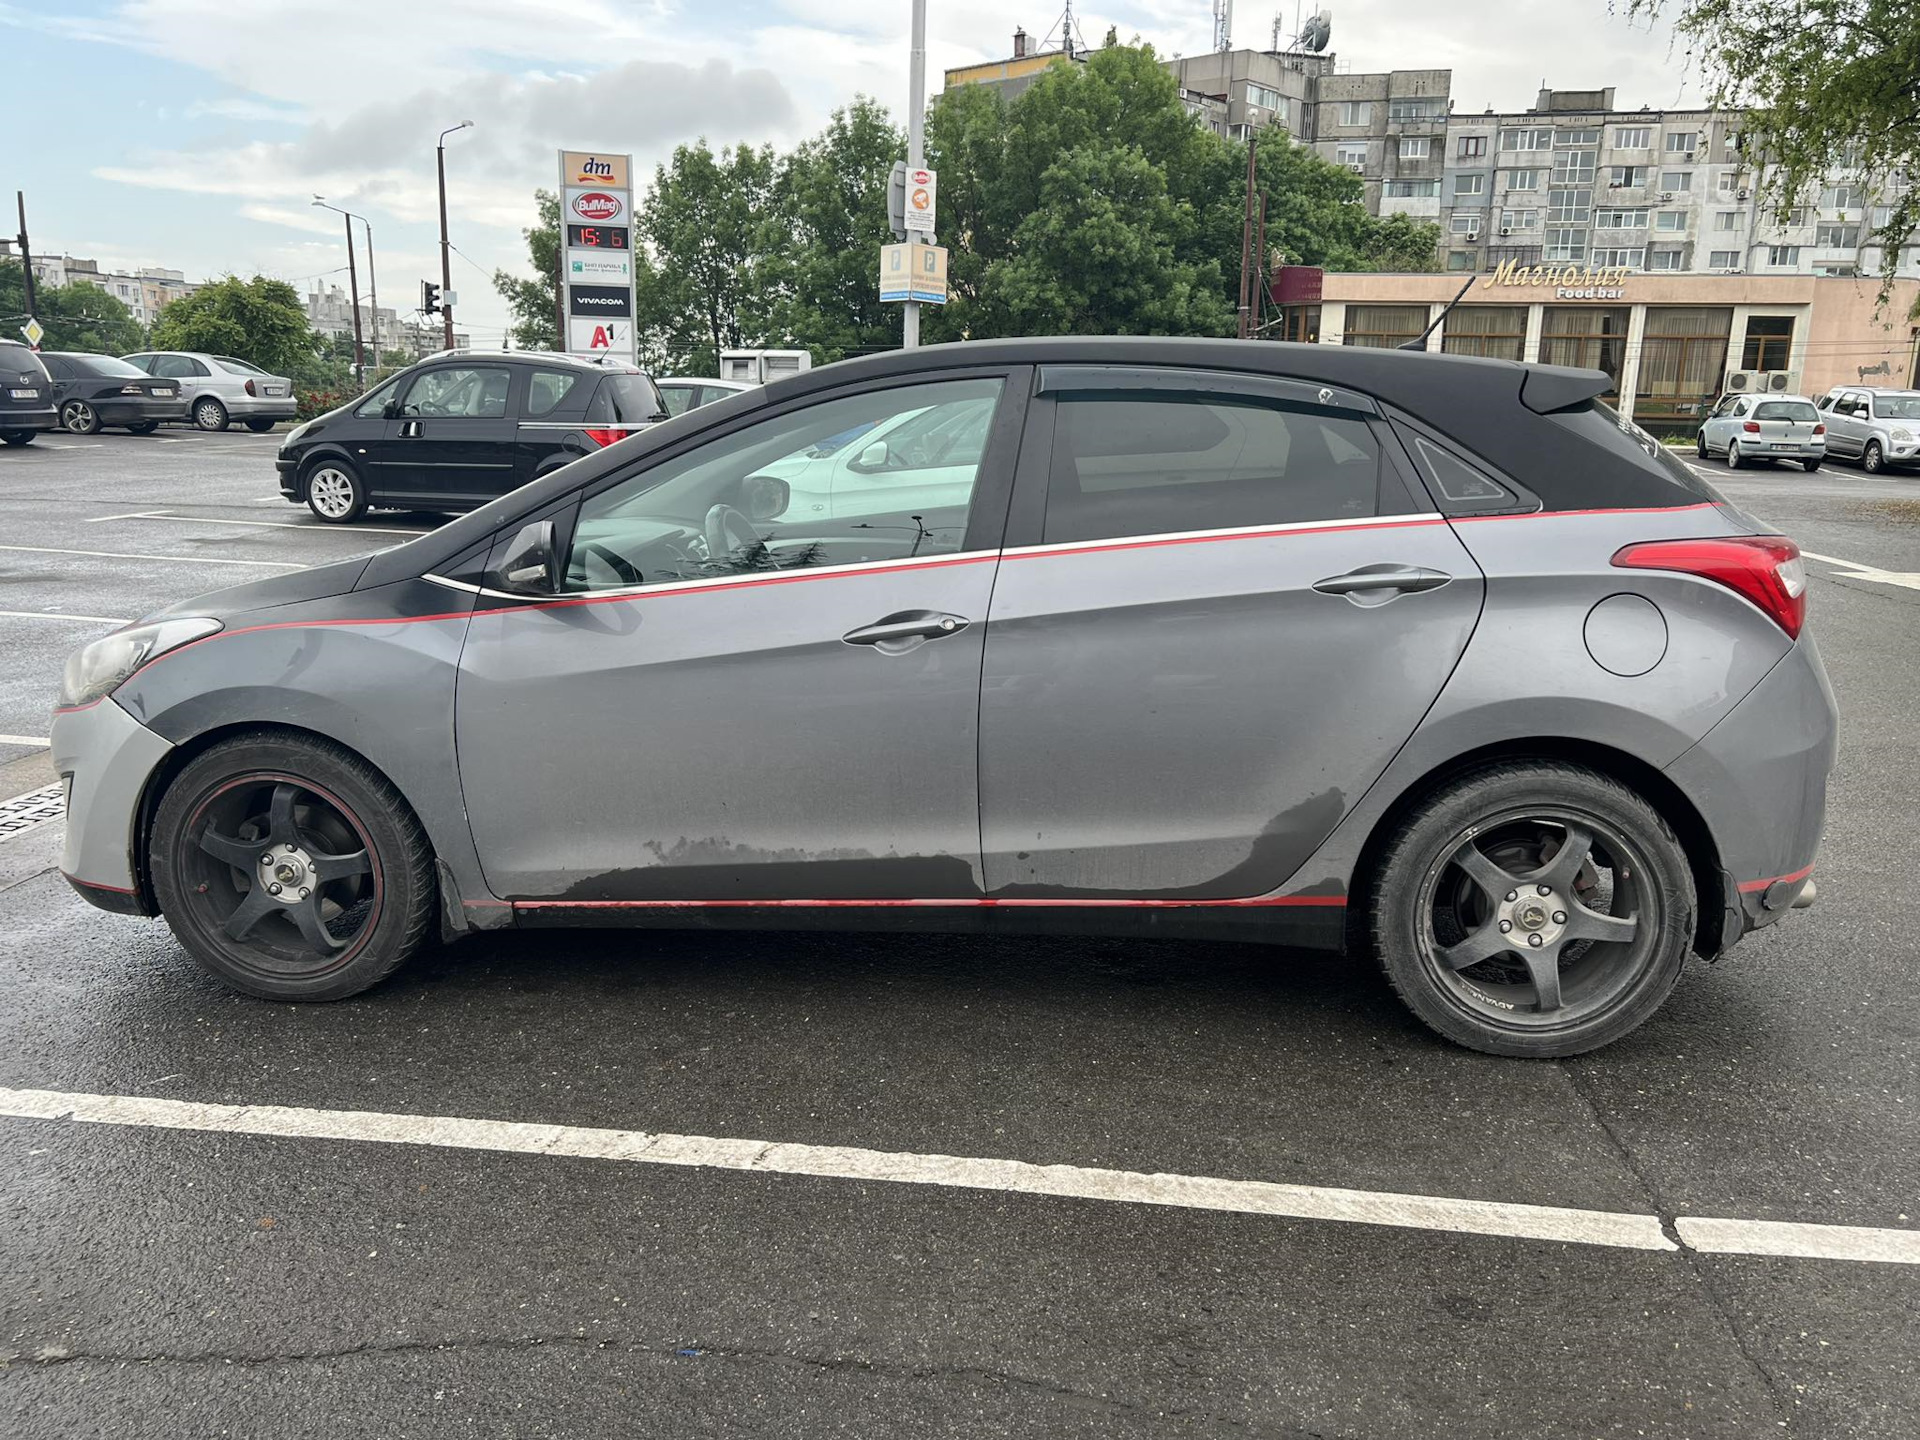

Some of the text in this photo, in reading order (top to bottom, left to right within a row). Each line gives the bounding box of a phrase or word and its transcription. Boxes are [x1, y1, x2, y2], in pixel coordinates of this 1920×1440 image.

[583, 157, 611, 175] dm
[579, 199, 616, 212] BulMag
[1483, 257, 1630, 289] Магнолия
[577, 297, 624, 305] VIVACOM
[1556, 288, 1624, 299] Food bar
[590, 323, 614, 348] A1
